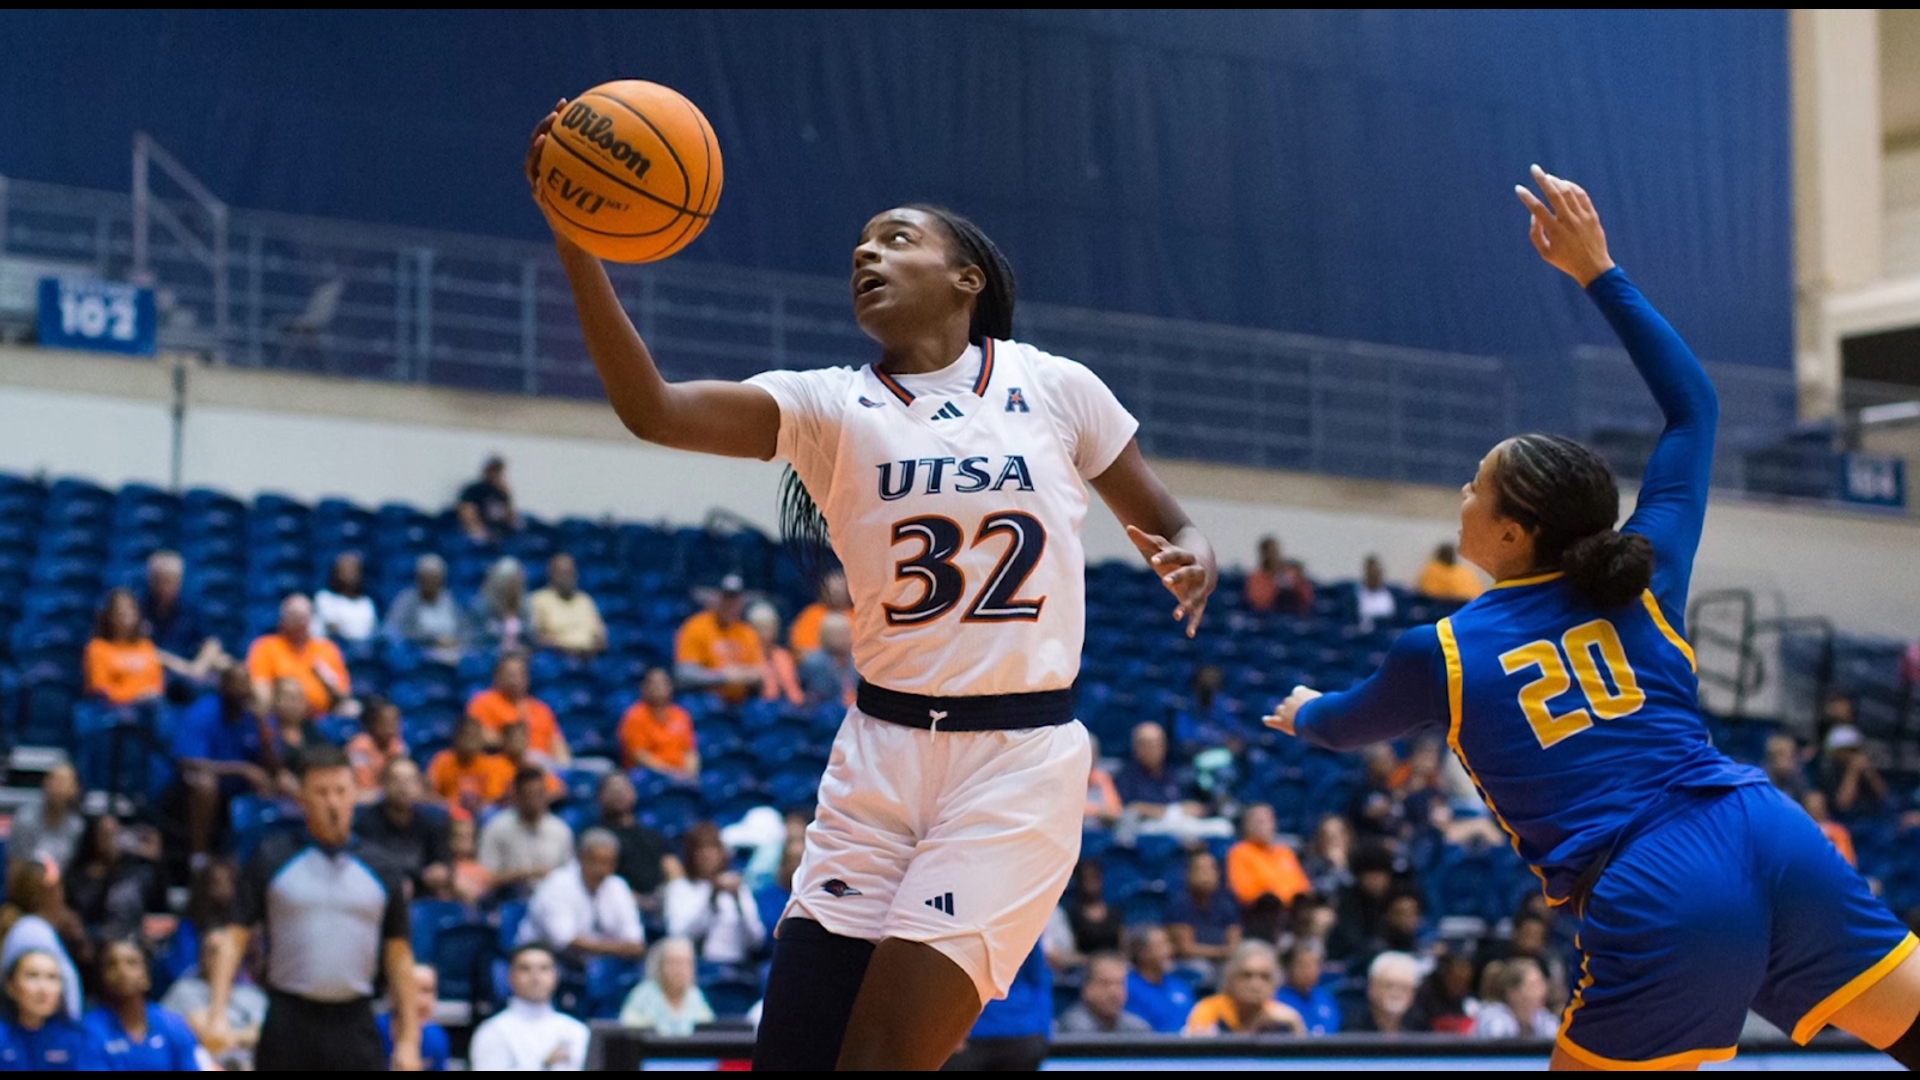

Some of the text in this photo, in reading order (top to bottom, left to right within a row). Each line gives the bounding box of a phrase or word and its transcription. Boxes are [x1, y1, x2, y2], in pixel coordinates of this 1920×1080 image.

[561, 102, 652, 180] Wilson
[547, 166, 606, 214] EVO
[61, 296, 137, 340] 102
[875, 455, 1035, 501] UTSA
[881, 510, 1048, 627] 32
[1498, 618, 1646, 750] 20
